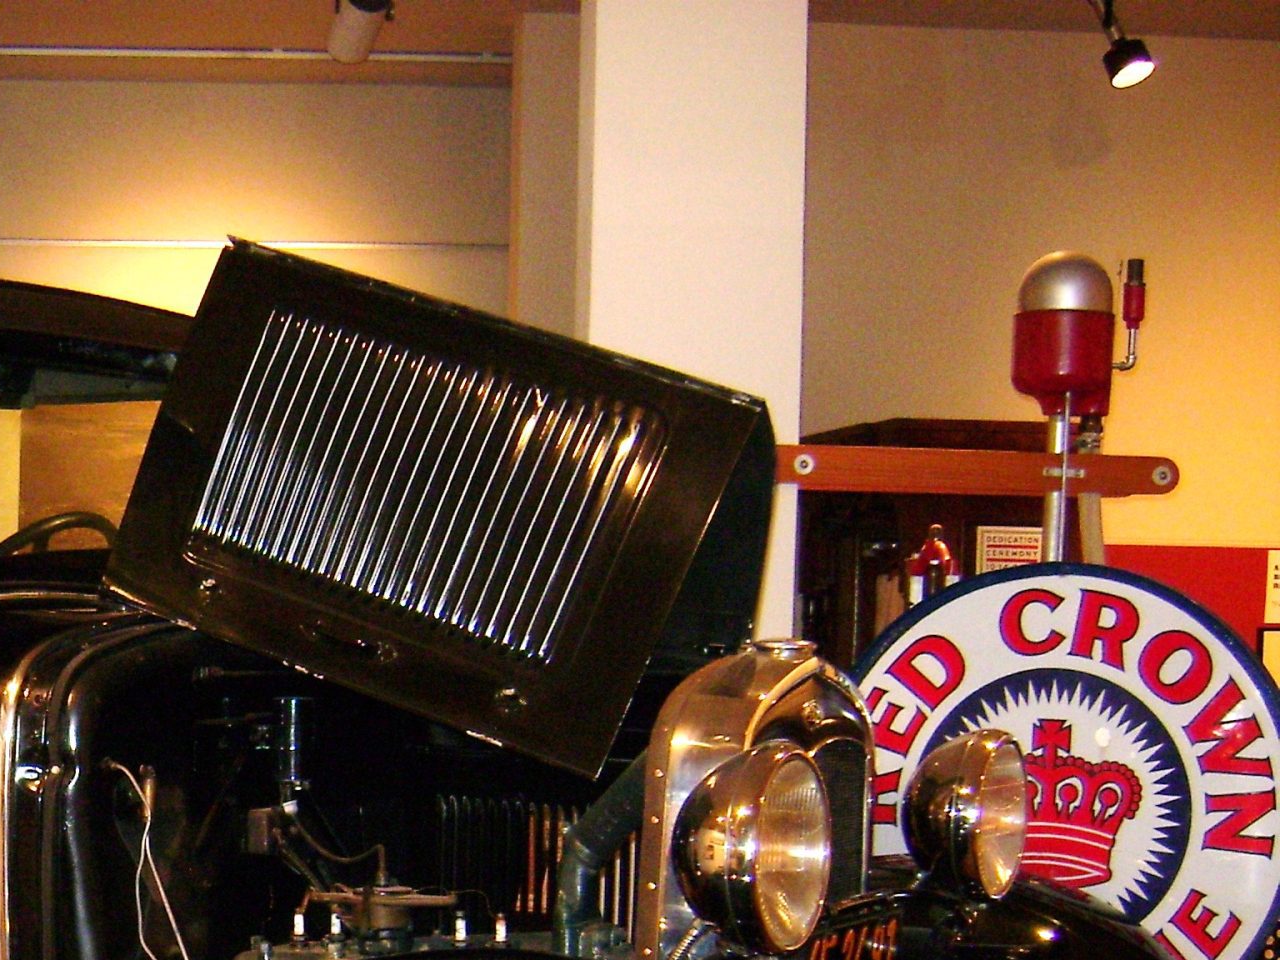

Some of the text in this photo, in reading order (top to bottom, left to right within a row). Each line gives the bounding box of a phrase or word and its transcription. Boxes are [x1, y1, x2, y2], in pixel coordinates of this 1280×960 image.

[985, 535, 1039, 544] DEDICATION
[985, 549, 1038, 557] CEREMONY
[999, 588, 1277, 860] CROWN
